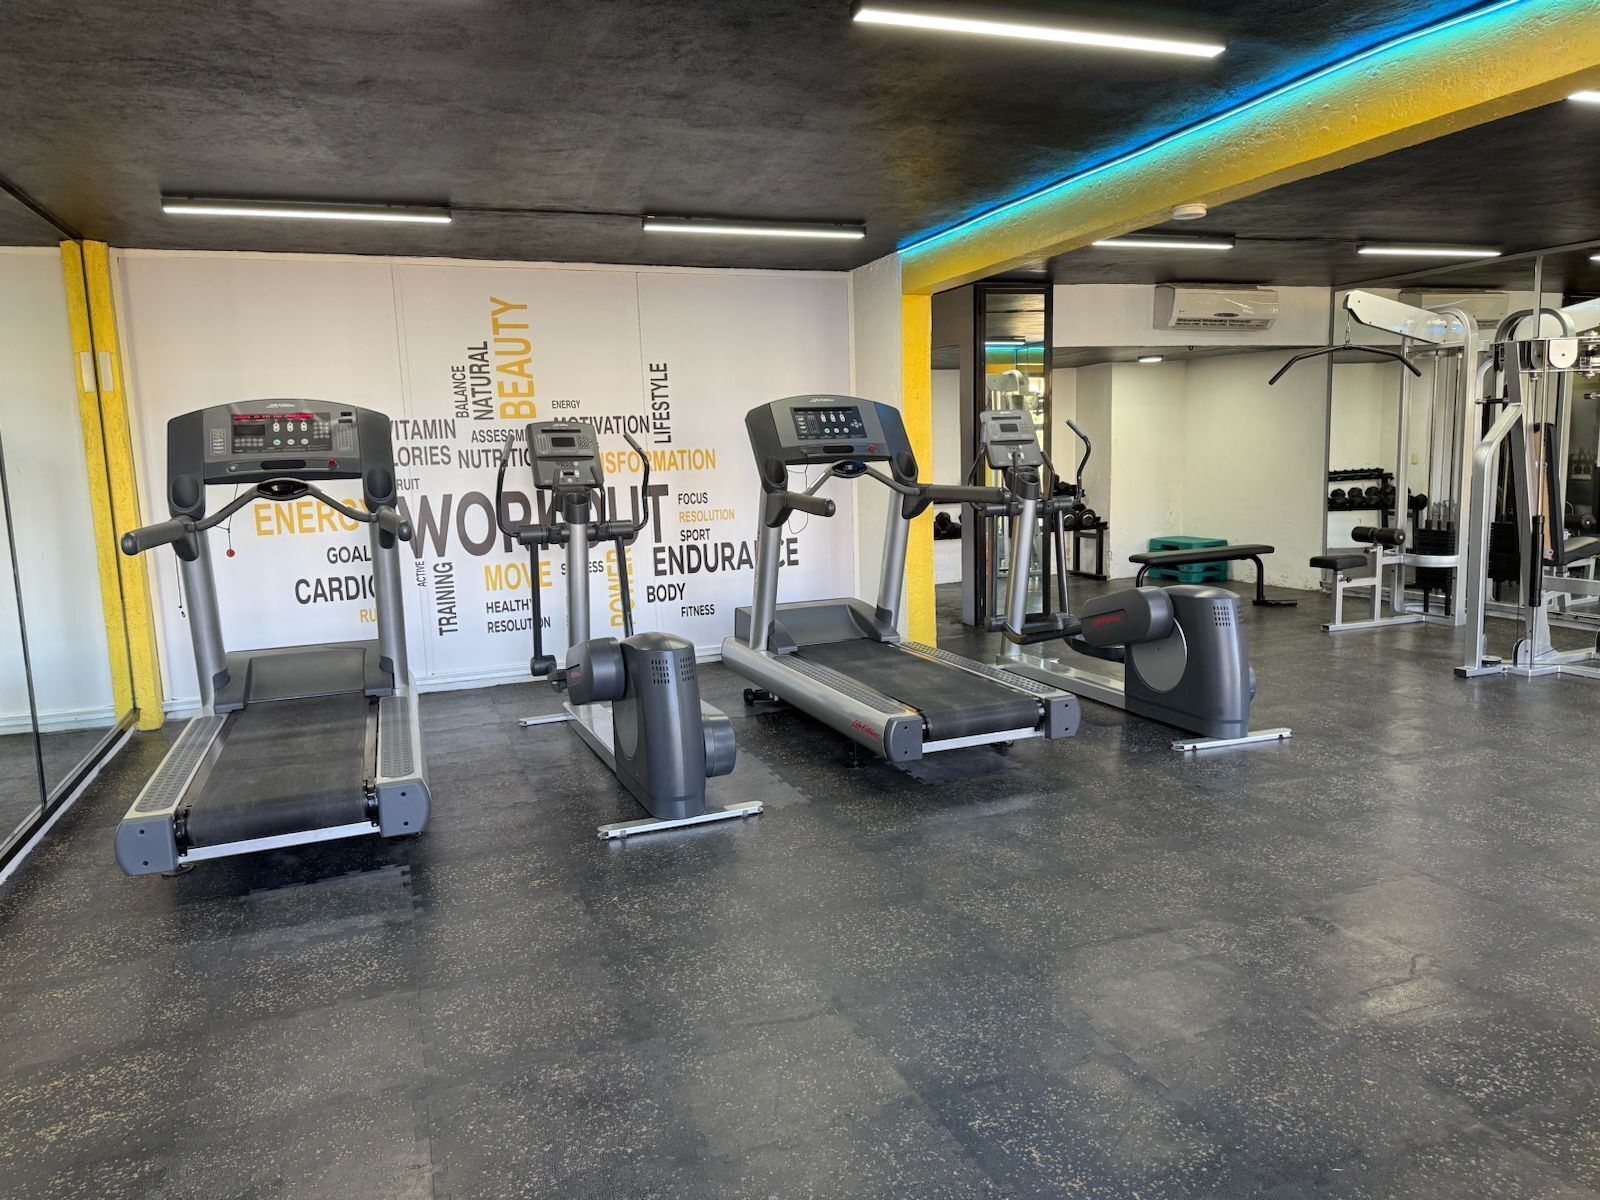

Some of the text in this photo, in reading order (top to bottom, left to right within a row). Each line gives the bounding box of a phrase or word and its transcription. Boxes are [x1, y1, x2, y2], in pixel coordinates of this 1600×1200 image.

[490, 296, 537, 419] BEAUTY
[451, 365, 469, 418] BALANCE
[467, 341, 494, 420] NATURAL
[552, 400, 581, 409] ENERGY
[649, 363, 672, 443] LIFESTYLE
[394, 445, 452, 467] ORIES
[678, 492, 708, 505] FOCUS
[254, 498, 369, 537] ENERG
[679, 508, 735, 523] RESOLUTION
[680, 528, 711, 542] SPORT
[653, 537, 800, 577] ENDURAE
[415, 560, 427, 587] ACTIVE
[433, 561, 459, 637] TRAINING
[646, 582, 686, 603] BODY
[486, 598, 532, 614] HEALTH
[681, 604, 716, 618] FITNESS
